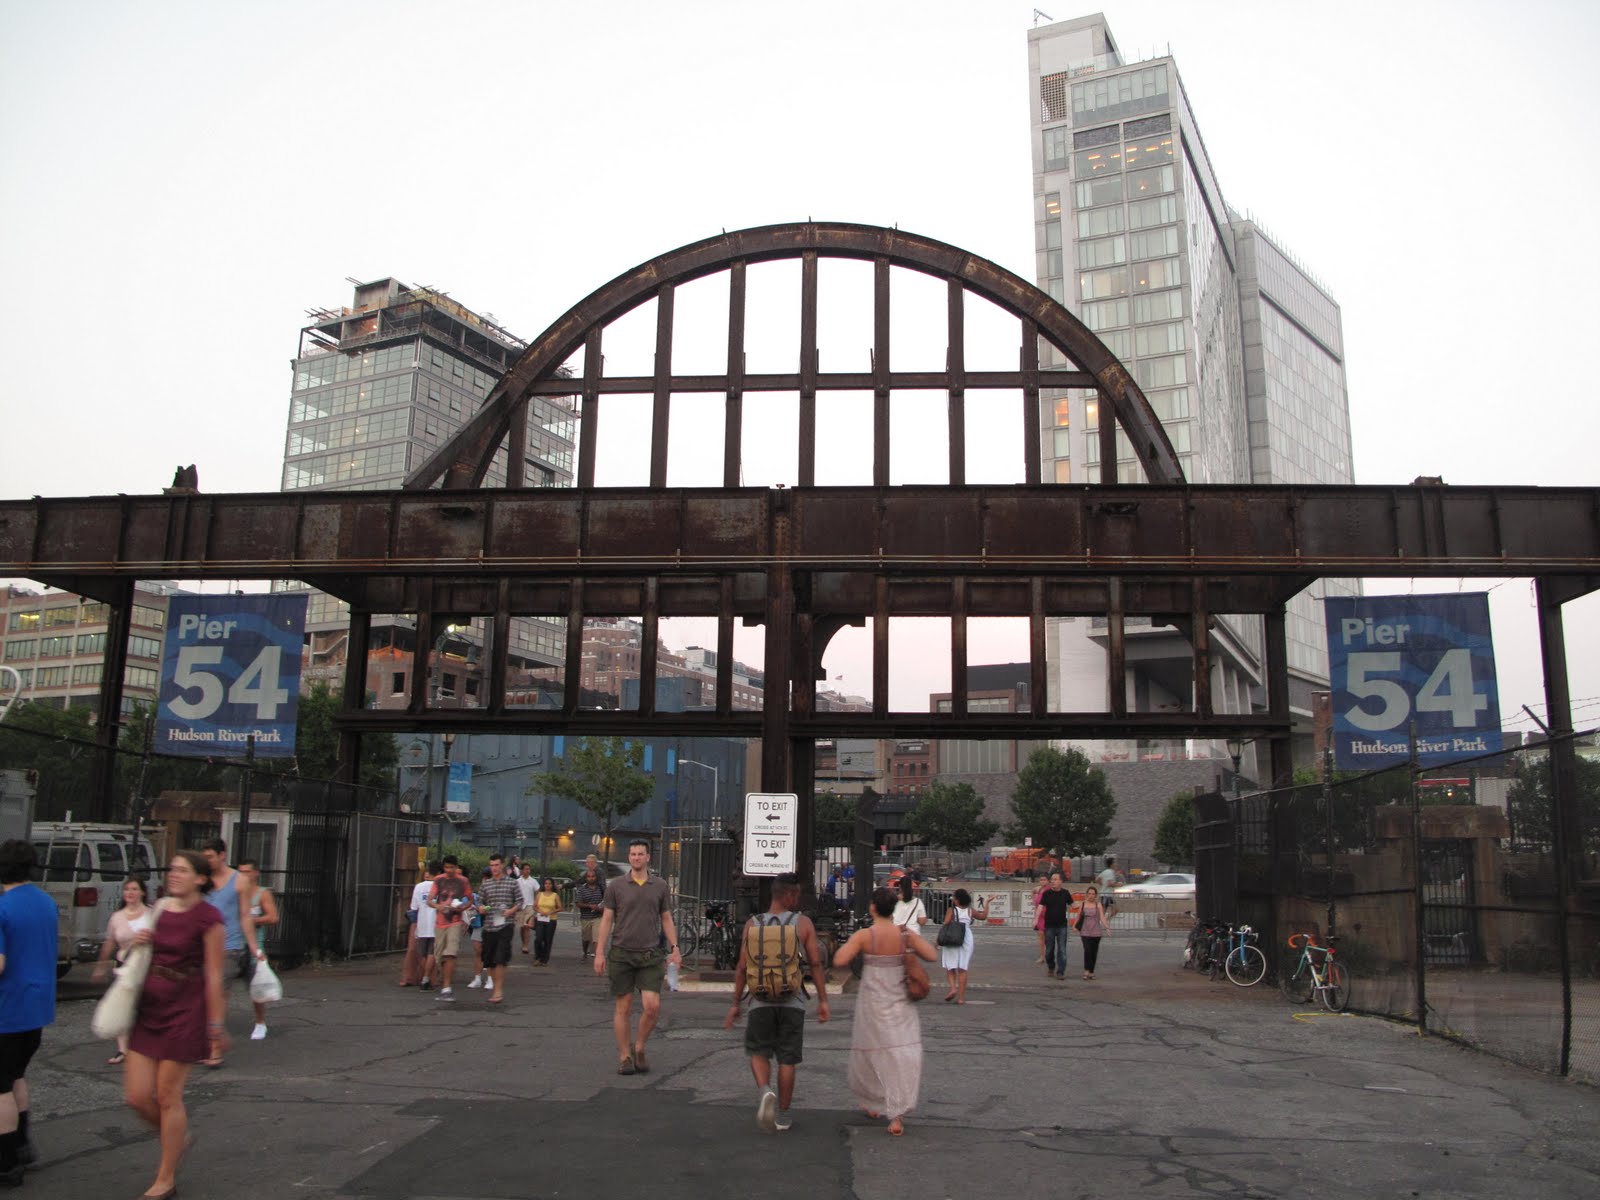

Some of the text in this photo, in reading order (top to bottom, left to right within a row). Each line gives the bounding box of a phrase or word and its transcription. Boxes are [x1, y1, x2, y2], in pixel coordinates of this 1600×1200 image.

[178, 614, 237, 639] Pier
[1341, 617, 1410, 645] Pier
[167, 646, 288, 720] 54
[1344, 648, 1488, 731] 54
[168, 727, 281, 742] Hudson River Park
[1351, 740, 1408, 754] Hudson
[1453, 737, 1488, 752] Park
[757, 802, 787, 810] TO EXIT
[756, 840, 786, 848] TO EXIT
